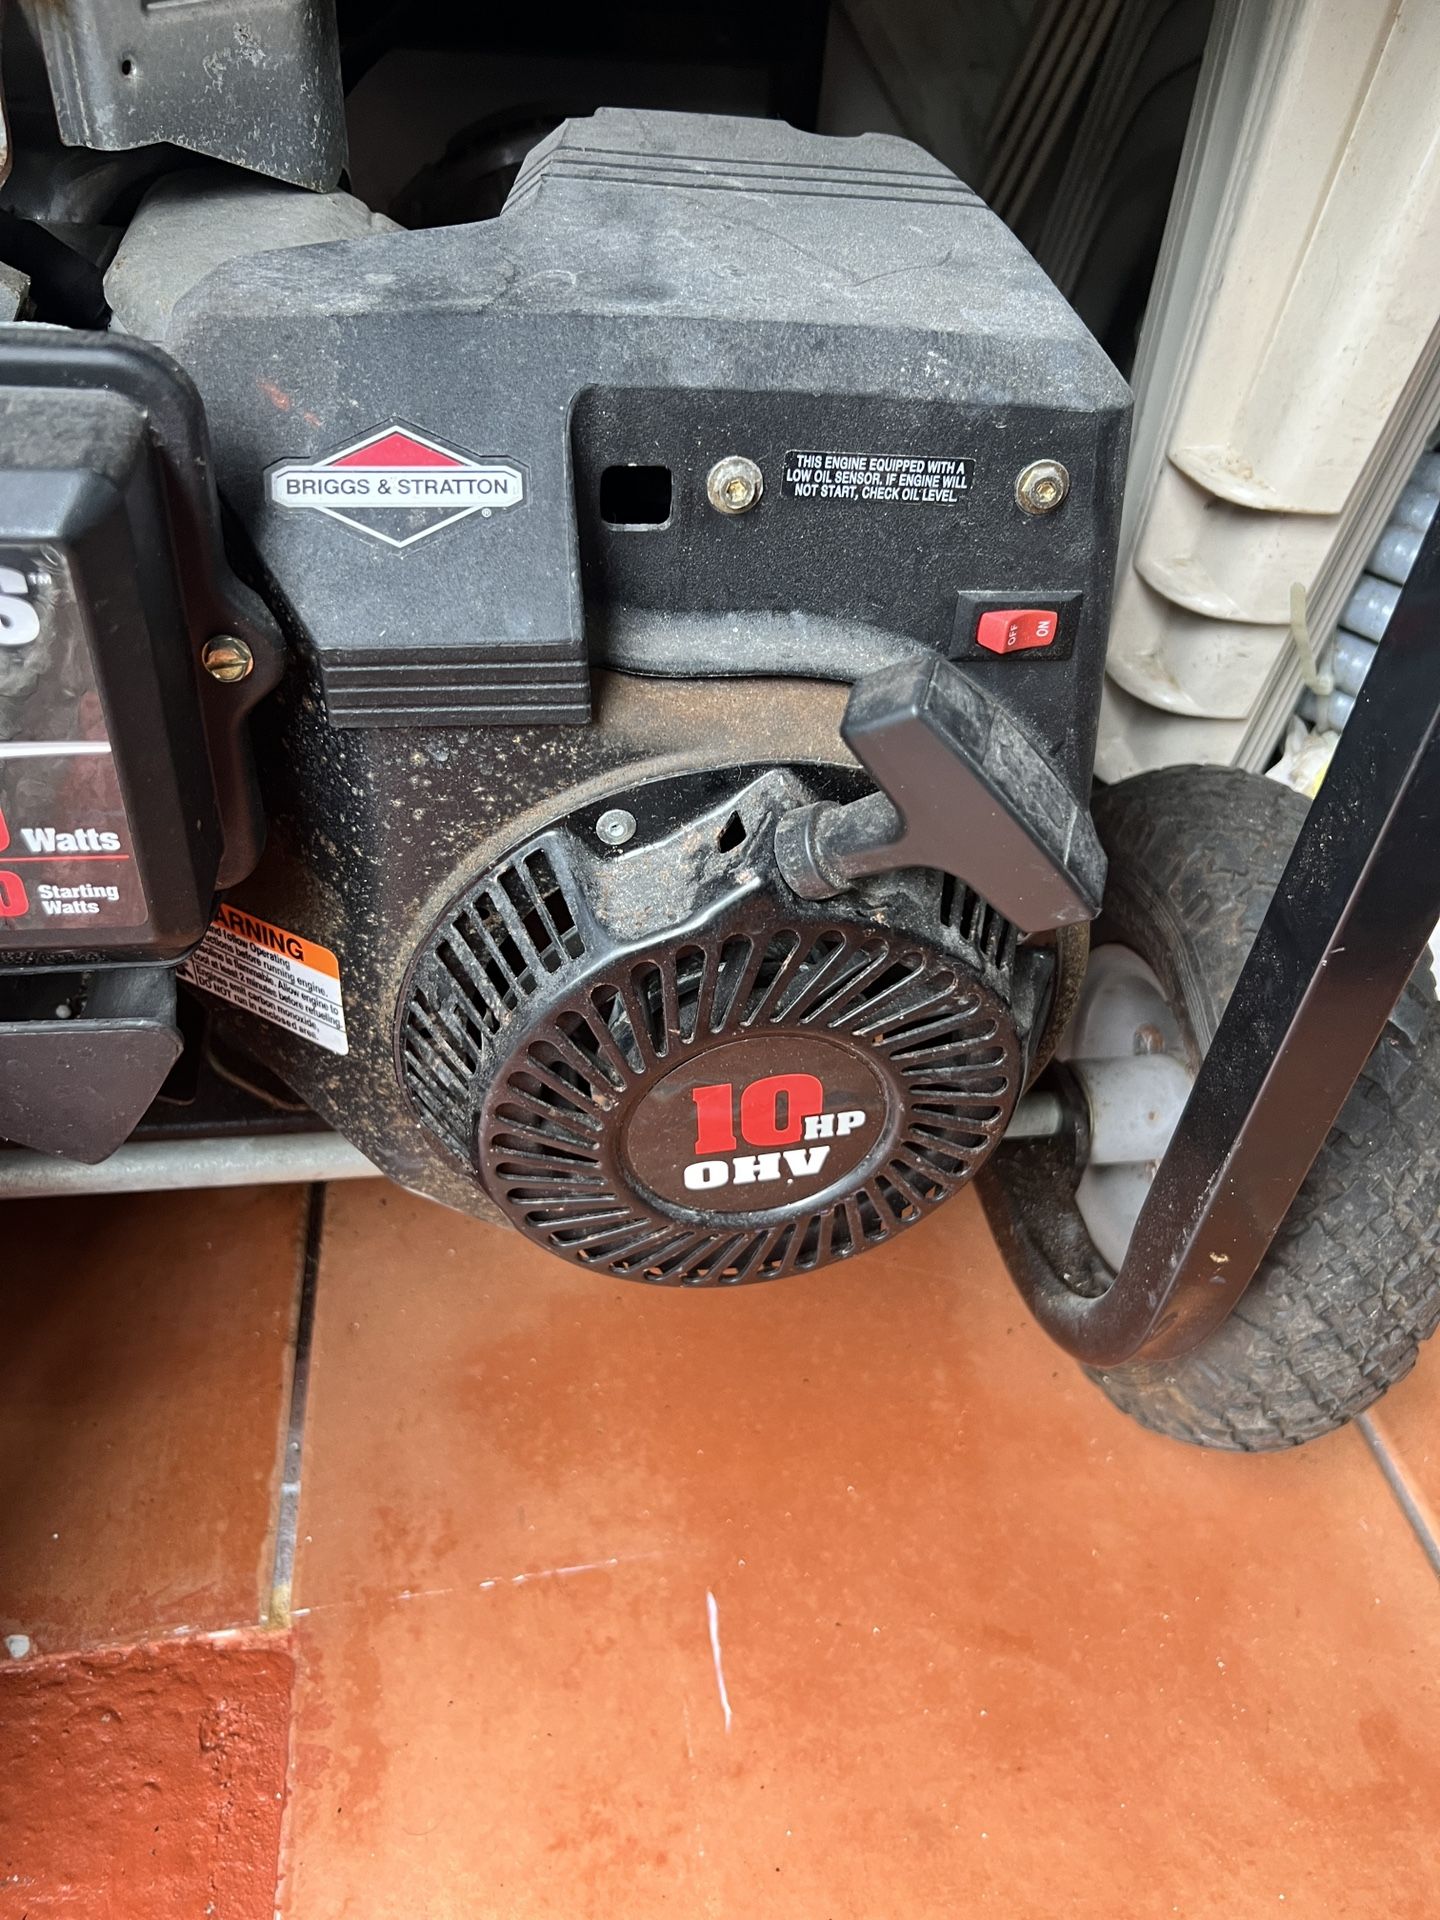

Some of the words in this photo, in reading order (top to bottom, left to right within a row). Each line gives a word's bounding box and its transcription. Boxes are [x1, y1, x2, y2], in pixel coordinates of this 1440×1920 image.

[786, 468, 812, 482] LOW
[814, 470, 832, 484] OIL
[834, 471, 882, 485] SENSOR.
[885, 474, 896, 485] IF
[899, 474, 940, 488] ENGINE
[942, 475, 967, 489] WILL
[797, 454, 822, 469] THIS
[824, 457, 867, 471] ENGINE
[869, 458, 924, 474] EQUIPPED
[927, 460, 954, 475] WITH
[956, 462, 965, 474] A
[286, 478, 370, 495] BRIGGS
[377, 478, 391, 495] &
[398, 478, 508, 495] STRATTON
[794, 484, 818, 497] NOT
[820, 485, 859, 501] START,
[861, 486, 900, 501] CHECK
[901, 487, 920, 501] OIL
[1007, 624, 1018, 646] OFF
[1035, 620, 1051, 637] ON
[20, 827, 121, 852] Watts
[37, 883, 120, 901] Starting
[41, 900, 100, 915] Watts
[213, 910, 305, 961] ARNING
[223, 930, 248, 949] follow
[249, 942, 290, 971] Operating
[205, 935, 234, 953] uctions
[235, 945, 261, 967] before
[263, 960, 296, 985] running
[296, 976, 329, 998] engine.
[196, 965, 228, 987] Engines
[229, 983, 247, 997] emit
[248, 991, 276, 1010] carbon
[199, 976, 212, 988] DO
[213, 982, 232, 998] NOT
[233, 995, 249, 1007] run
[249, 1000, 258, 1010] in
[259, 1006, 297, 1029] enclosed
[240, 972, 246, 981] 2
[246, 976, 277, 997] minutes
[279, 992, 304, 1010] before
[278, 980, 299, 997] Allow
[301, 990, 332, 1010] engine
[330, 1004, 339, 1015] to
[692, 1073, 824, 1155] 10
[803, 1110, 866, 1141] HP
[683, 1145, 831, 1191] OHV
